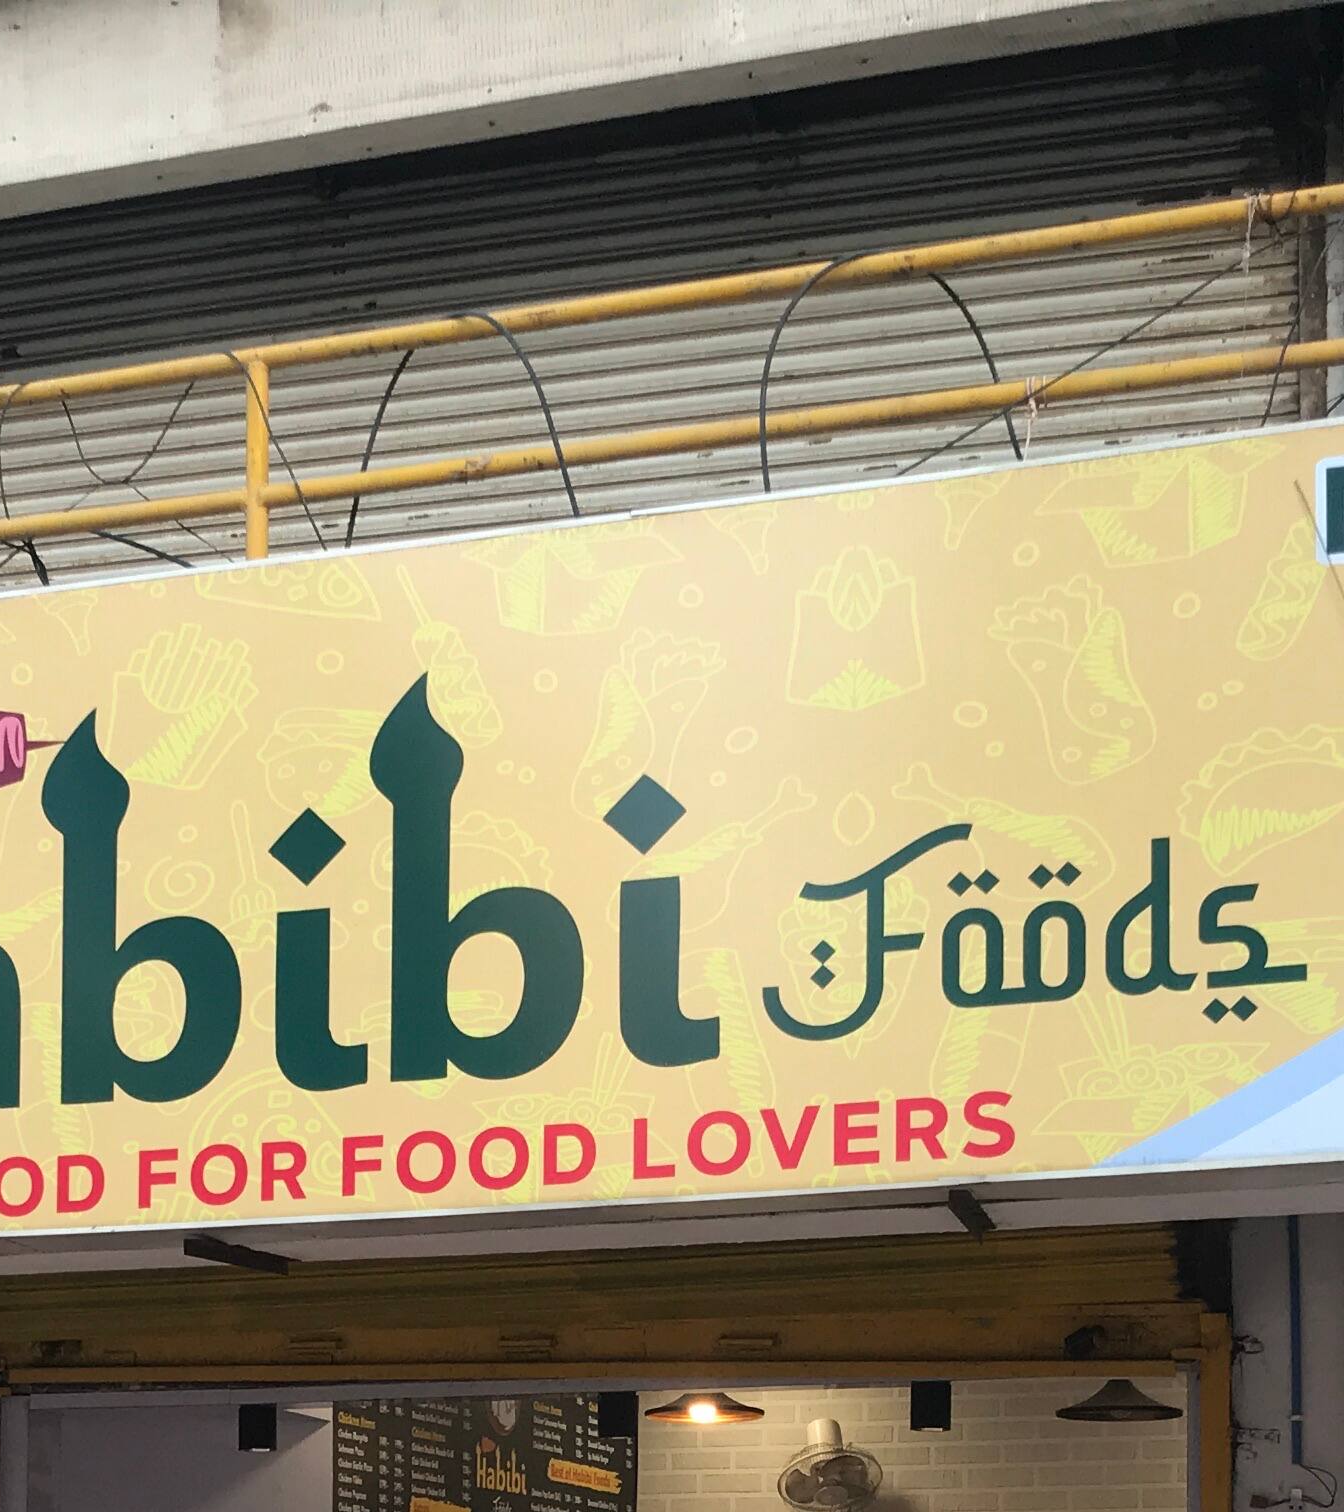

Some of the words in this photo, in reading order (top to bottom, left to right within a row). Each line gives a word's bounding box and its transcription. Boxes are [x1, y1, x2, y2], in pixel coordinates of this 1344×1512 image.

[137, 1141, 309, 1209] FOR
[340, 1122, 597, 1197] FOOD
[632, 1090, 1016, 1180] LOVERS
[475, 1441, 528, 1496] Habibi
